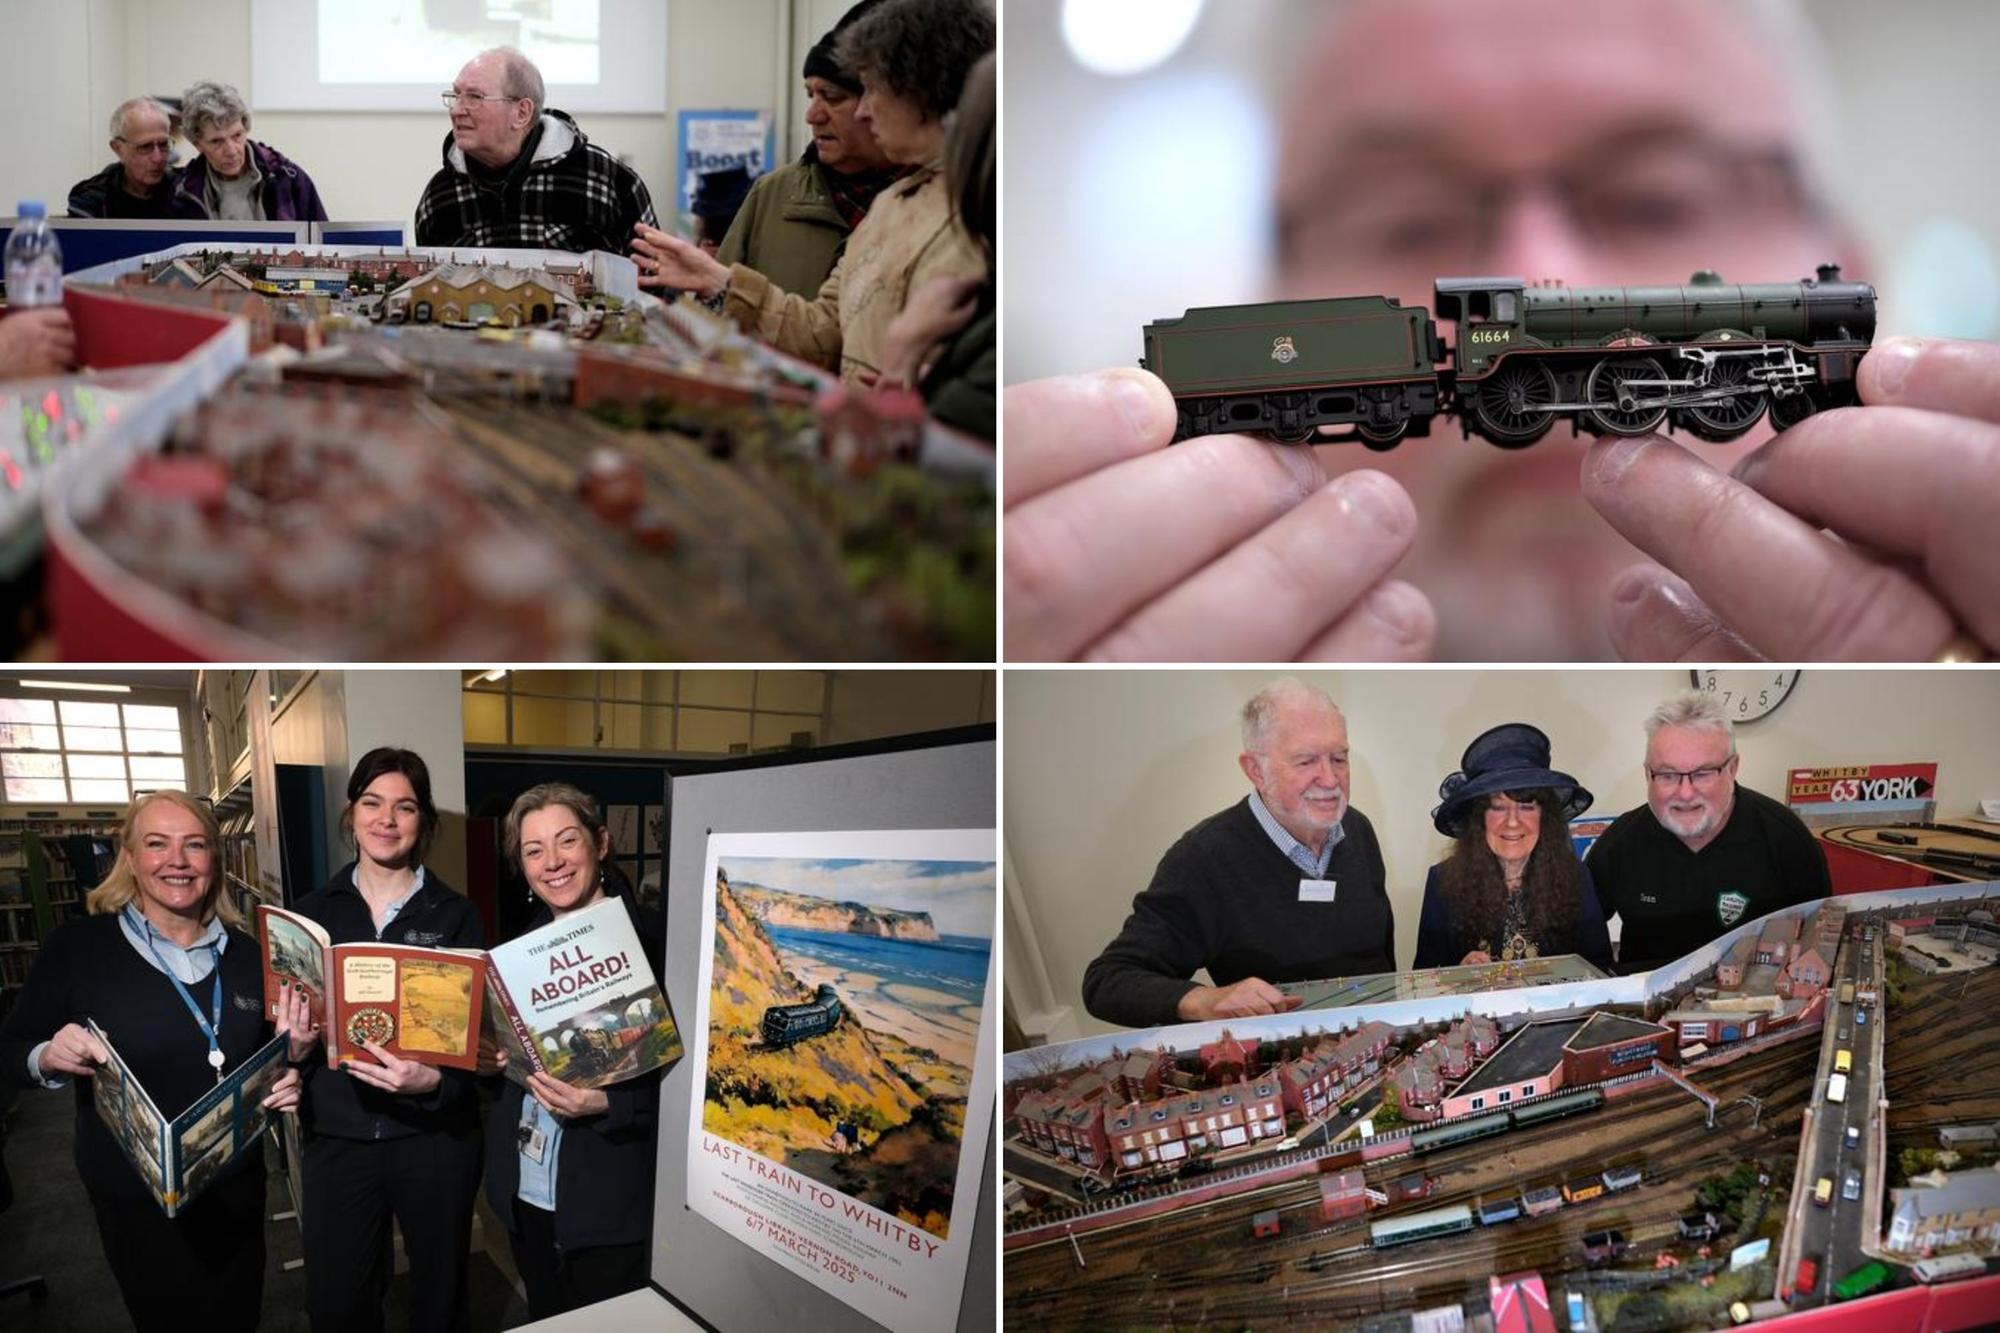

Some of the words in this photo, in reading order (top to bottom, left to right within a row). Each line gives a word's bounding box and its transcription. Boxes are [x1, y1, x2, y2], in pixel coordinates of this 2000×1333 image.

[687, 149, 760, 170] Boost
[1471, 330, 1510, 344] 61664
[1707, 676, 1717, 692] 8
[1774, 672, 1783, 688] 4
[1723, 692, 1732, 706] 7
[1739, 697, 1748, 712] 6
[1759, 690, 1768, 706] 5
[1812, 767, 1868, 779] WHITBY
[1794, 783, 1828, 794] YEAR
[1831, 779, 1860, 802] 63
[1861, 776, 1917, 800] YORK
[527, 944, 546, 957] THE
[566, 924, 595, 941] TIMES
[549, 945, 594, 976] ALL
[530, 951, 631, 1006] ABOARD!
[535, 995, 579, 1014] Remembering
[579, 985, 605, 1000] Britain's
[605, 973, 633, 989] Railways
[511, 1015, 524, 1034] ALL
[521, 1035, 544, 1072] ABOARD
[703, 1136, 742, 1164] LAST
[747, 1156, 801, 1194] TRAIN
[808, 1185, 835, 1209] TO
[842, 1200, 939, 1258] WHITBY
[712, 1190, 764, 1221] SCARBOROUGH
[799, 1235, 832, 1257] VERNON
[746, 1216, 764, 1233] 6/7
[768, 1226, 819, 1263] MARCH
[823, 1257, 856, 1284] 2025
